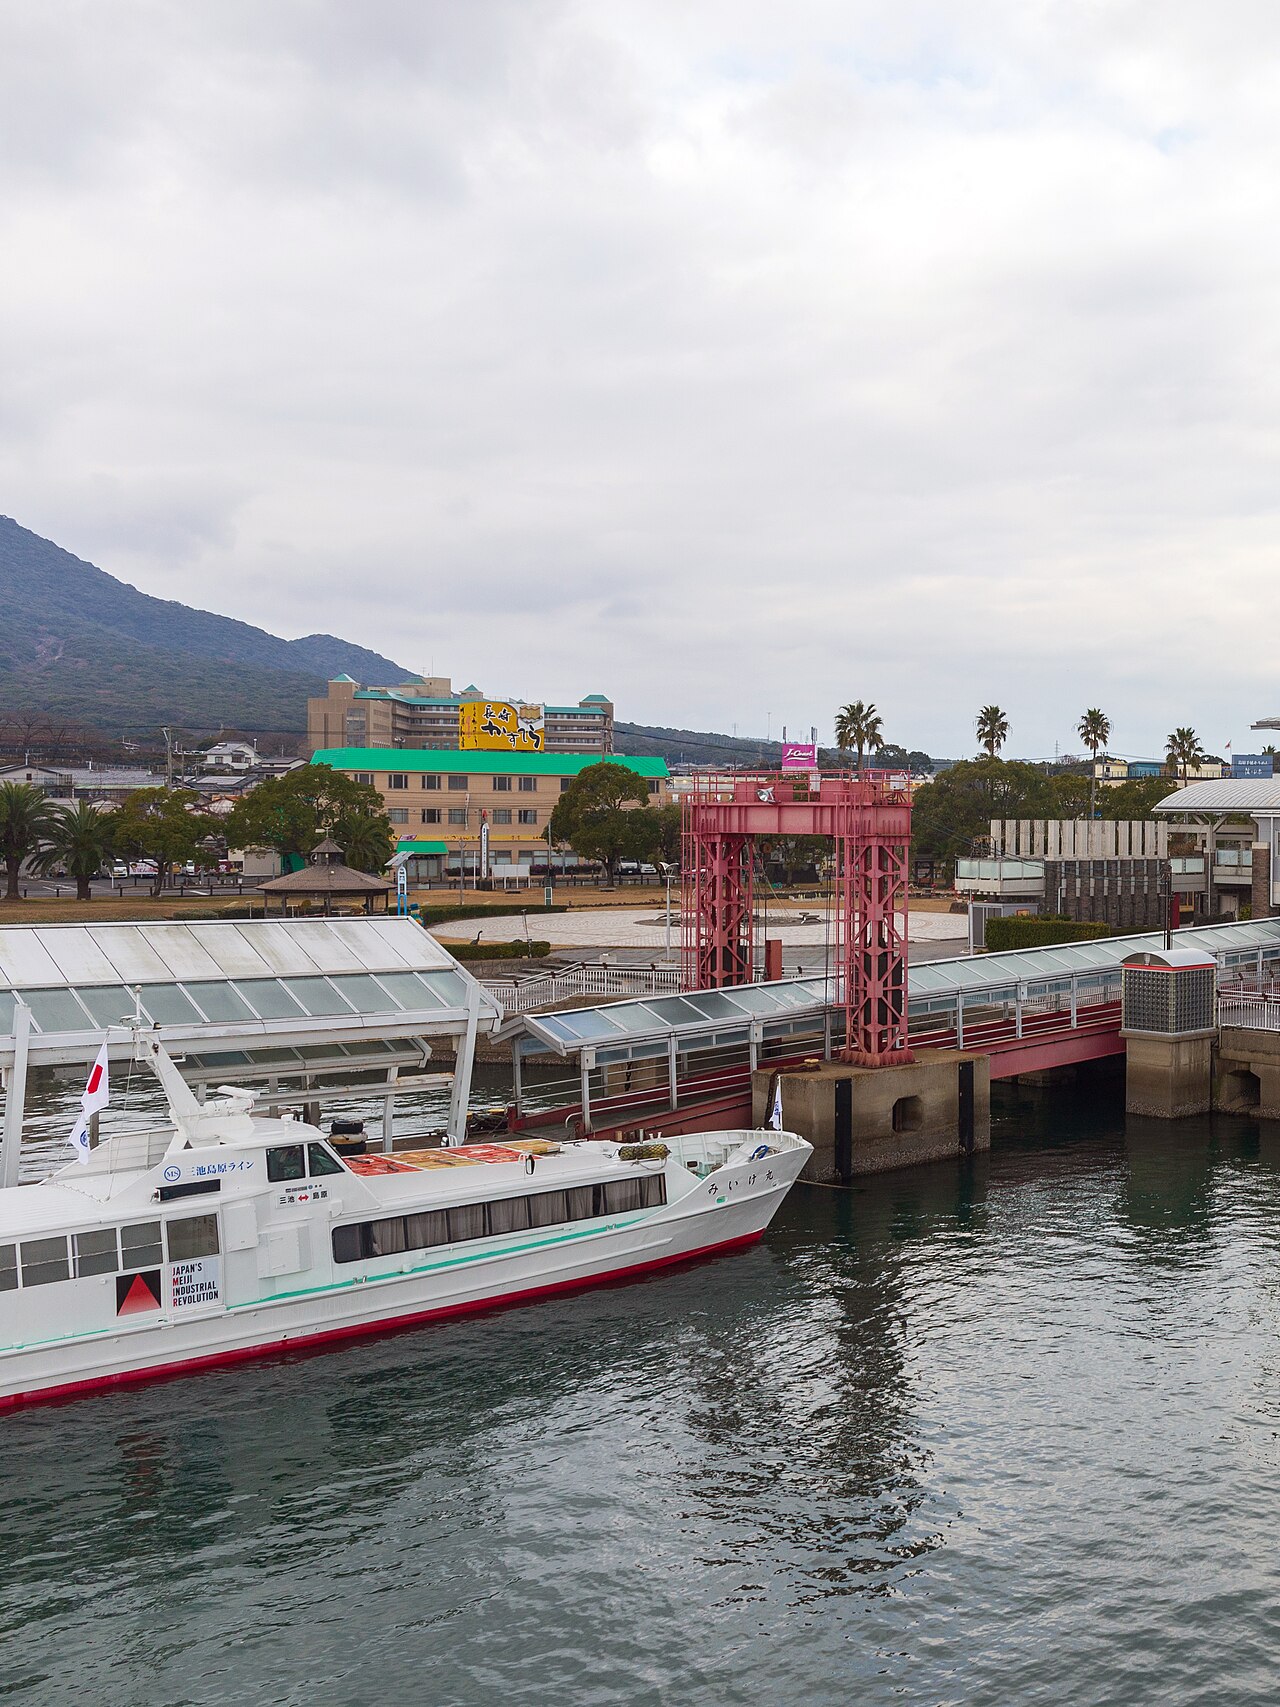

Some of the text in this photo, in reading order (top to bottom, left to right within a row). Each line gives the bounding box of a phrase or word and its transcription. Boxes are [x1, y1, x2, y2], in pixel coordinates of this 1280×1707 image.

[483, 704, 511, 722] 長崎
[185, 1161, 255, 1176] 三池島原ライン
[172, 1262, 203, 1276] JAPAN'S
[172, 1274, 193, 1287] MEIJI
[172, 1280, 217, 1297] INDUSTRIAL
[172, 1290, 219, 1307] REVOLUTION
